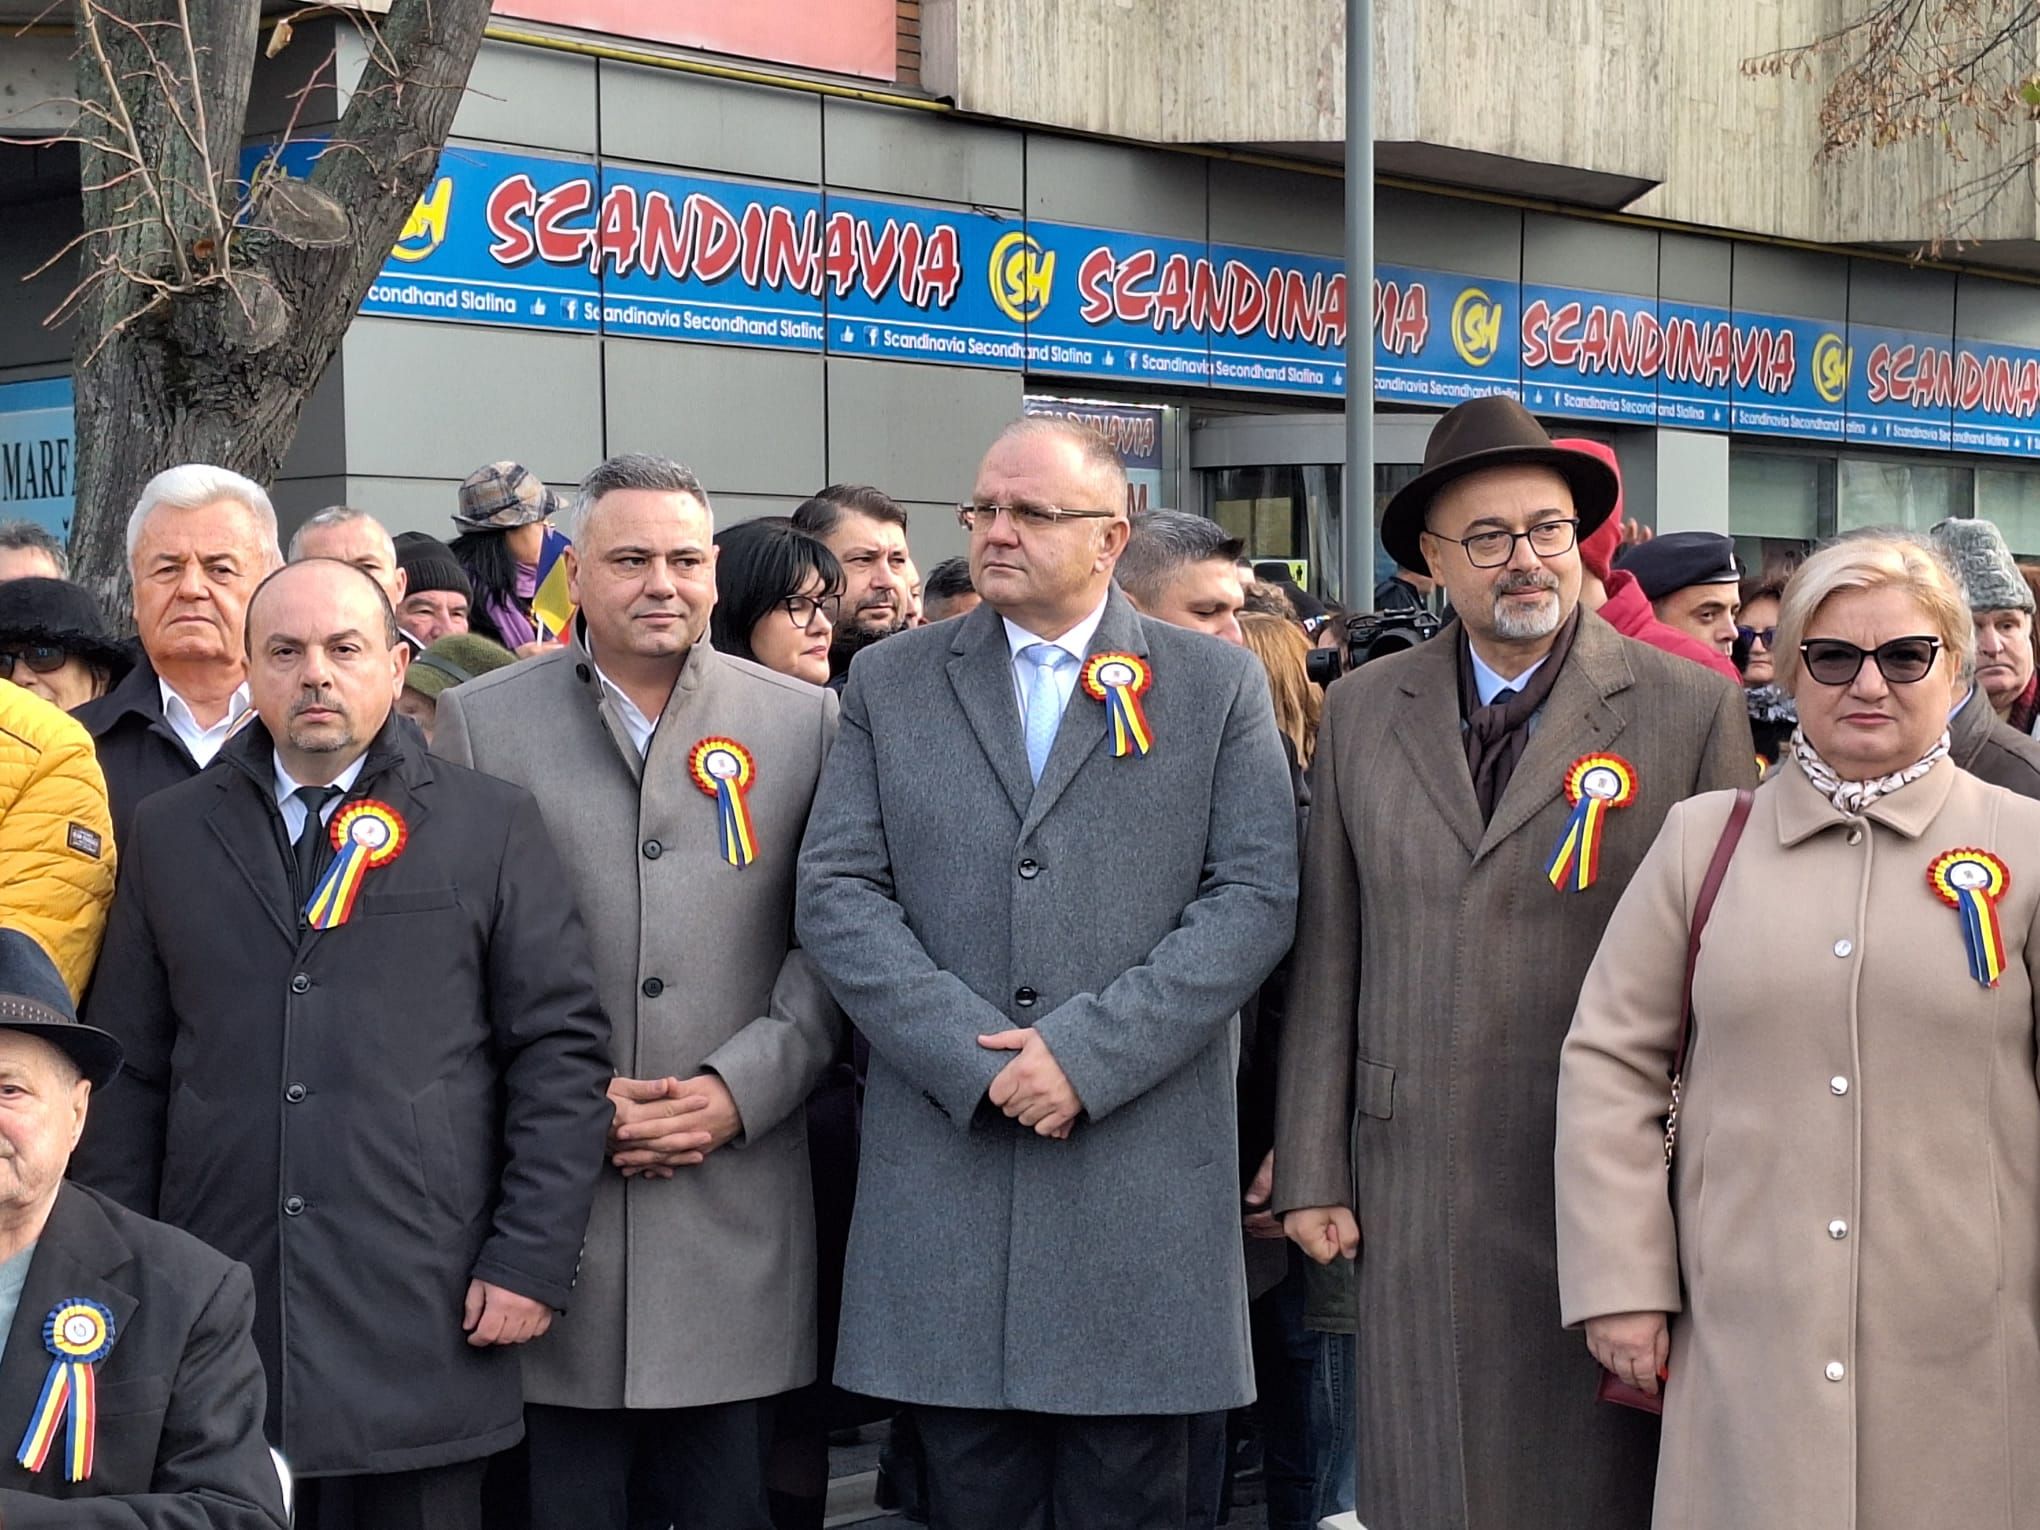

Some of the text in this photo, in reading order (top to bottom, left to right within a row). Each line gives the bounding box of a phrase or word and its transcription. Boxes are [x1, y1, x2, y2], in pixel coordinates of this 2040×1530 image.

[486, 174, 960, 308] SCANDINAVIA
[368, 285, 516, 313] condhand Slatina
[584, 301, 680, 328] Scandinavia
[683, 310, 777, 336] Secondhand
[884, 330, 965, 352] Scandinavia
[968, 338, 1049, 361] Secondhand
[1051, 346, 1092, 365] Slatina
[1522, 299, 1795, 394] SCANDINAVIA
[1142, 354, 1213, 375] Scandinavia
[1216, 360, 1285, 382] Secondhand
[1288, 367, 1323, 385] Slatina
[1375, 377, 1429, 395] candinavia
[1867, 343, 2040, 418] SCANDINA
[1564, 393, 1619, 412] Scandinavia
[1677, 404, 1705, 421] Slatina
[2, 438, 77, 502] MARF
